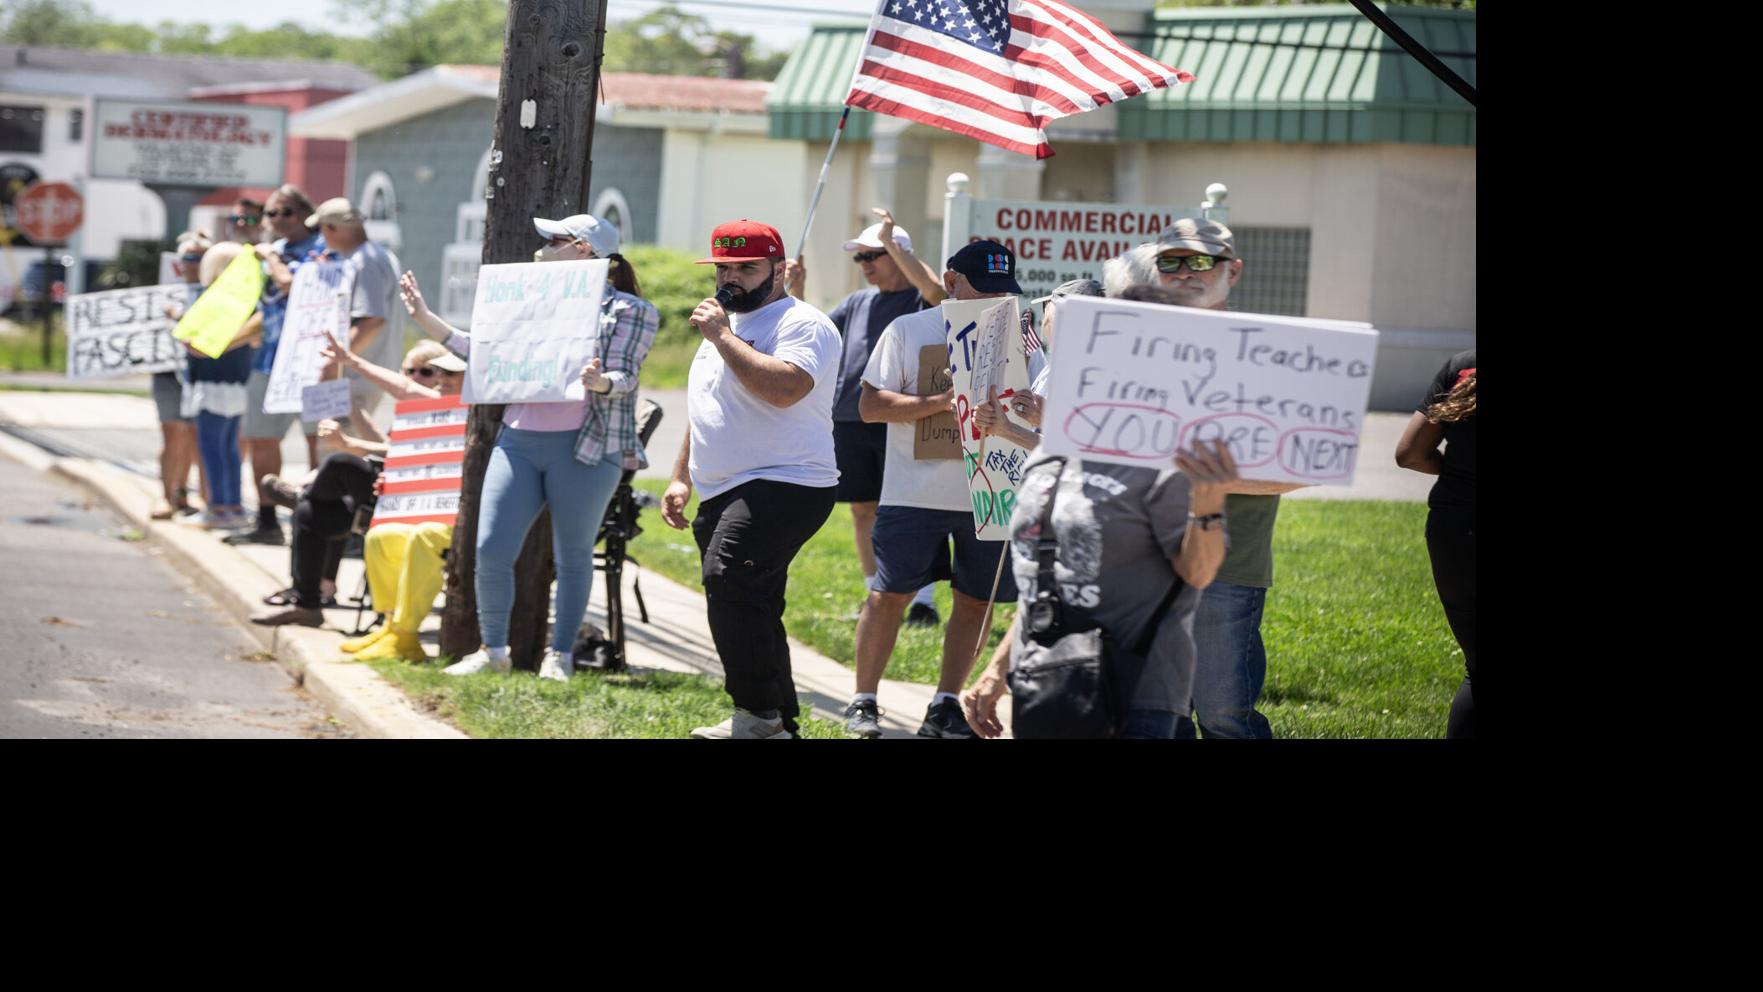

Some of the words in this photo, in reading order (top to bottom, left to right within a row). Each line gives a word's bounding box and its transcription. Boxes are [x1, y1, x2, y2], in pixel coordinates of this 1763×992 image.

[484, 271, 526, 303] Honk
[537, 271, 551, 299] 4
[1086, 310, 1218, 381] Firing
[1077, 366, 1169, 411] Firing
[1181, 377, 1358, 430] Veterans
[986, 449, 1006, 472] TAX
[1000, 448, 1020, 474] THE
[1073, 406, 1180, 454] YOU
[1290, 434, 1359, 473] NEXT
